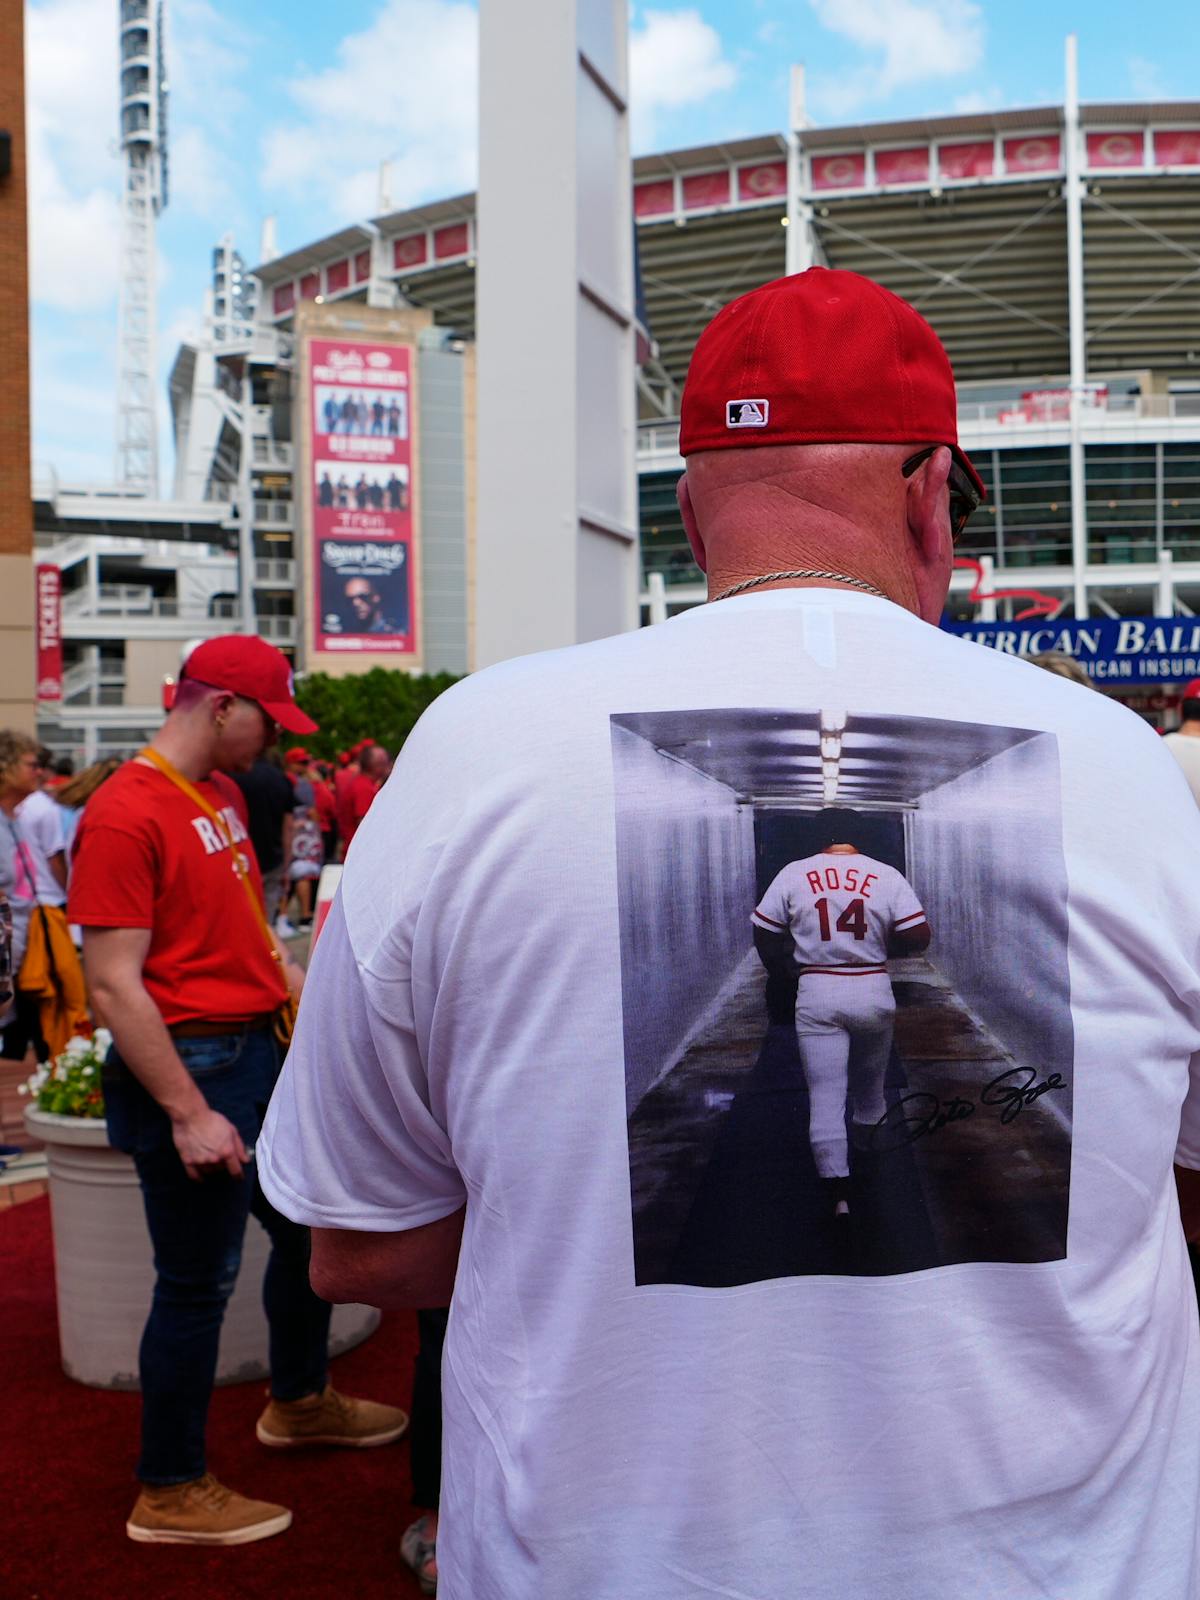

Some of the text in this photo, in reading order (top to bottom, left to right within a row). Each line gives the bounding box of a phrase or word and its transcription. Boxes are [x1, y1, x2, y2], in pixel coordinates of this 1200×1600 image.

[40, 571, 59, 650] TICKETS
[950, 629, 1102, 657] ERICAN
[1081, 659, 1133, 678] RICAN
[806, 867, 879, 899] ROSE
[814, 897, 868, 942] 14
